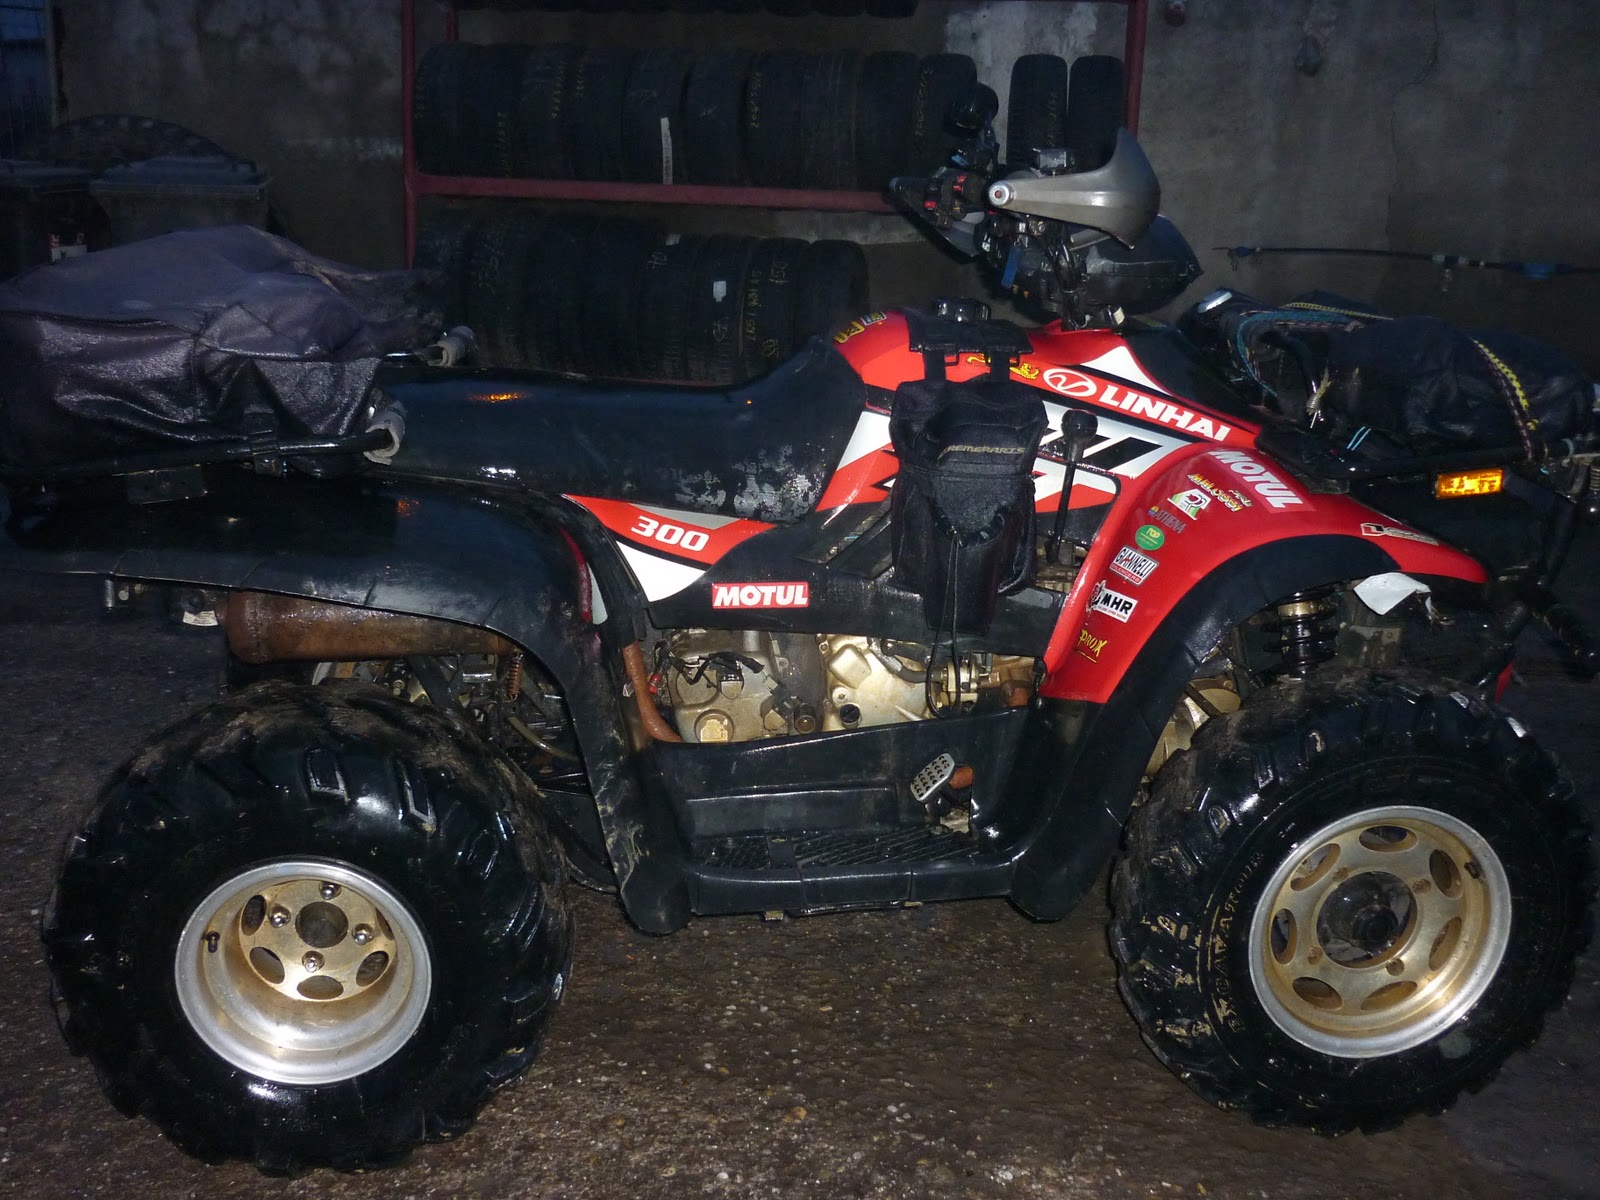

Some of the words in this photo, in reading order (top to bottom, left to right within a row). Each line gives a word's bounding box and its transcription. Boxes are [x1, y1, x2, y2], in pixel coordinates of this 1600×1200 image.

[1098, 384, 1231, 442] LINHAI
[1187, 473, 1244, 512] MALOSSI
[1208, 450, 1304, 509] MOTUL
[630, 515, 710, 552] 300
[1154, 509, 1187, 535] ATHENA
[713, 585, 809, 607] MOTUL
[1100, 593, 1133, 615] MHR
